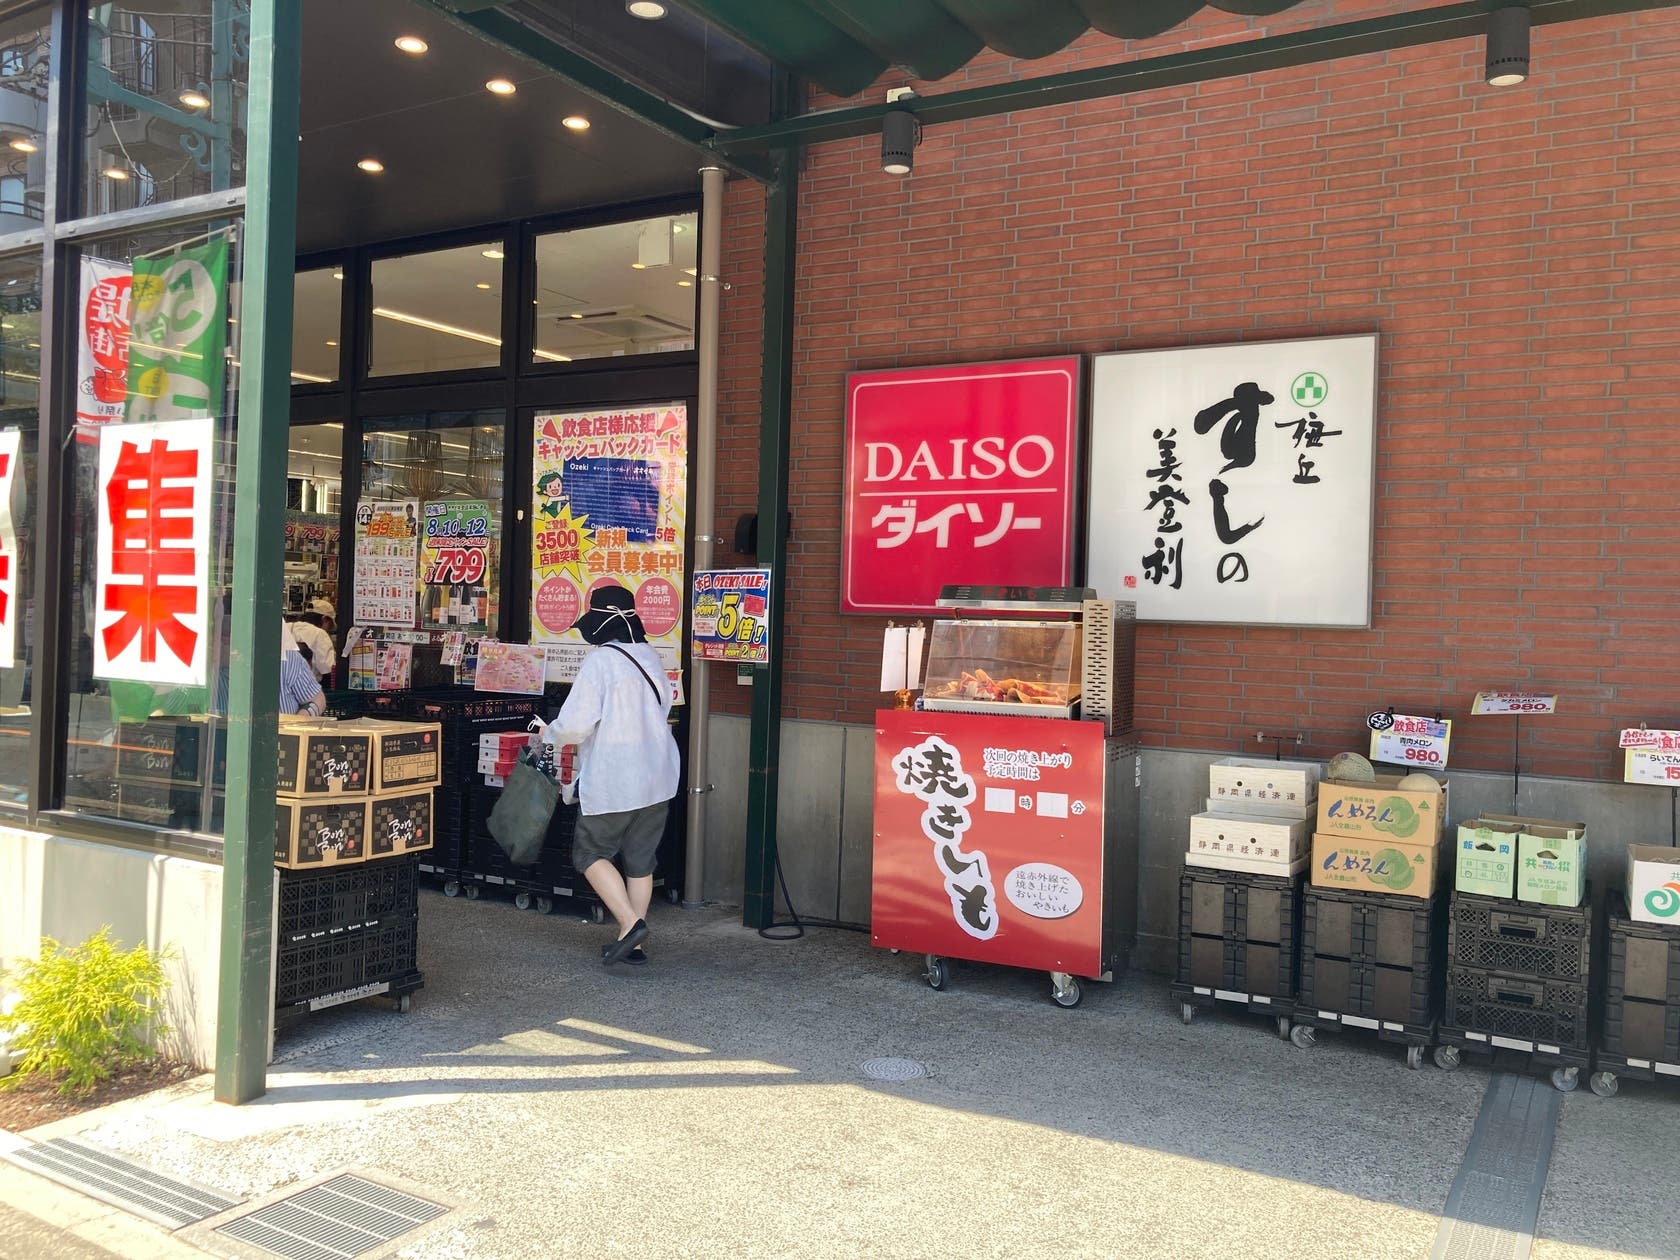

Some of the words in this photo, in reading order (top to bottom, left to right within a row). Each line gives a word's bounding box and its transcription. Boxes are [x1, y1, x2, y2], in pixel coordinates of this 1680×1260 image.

[561, 412, 656, 438] 飲食店様応援
[538, 433, 681, 460] キャッシュバックカード
[1274, 411, 1343, 484] 梅丘
[570, 462, 589, 471] Ozeki
[864, 434, 1055, 482] DAISO
[1195, 381, 1275, 584] すしの
[1141, 428, 1191, 590] 美登利
[871, 502, 1042, 549] ダイソー
[536, 529, 578, 550] 3500
[596, 529, 628, 548] 新規
[656, 527, 676, 542] 5倍
[102, 439, 198, 668] 集
[539, 549, 580, 566] 店舗突破
[588, 551, 683, 575] 会員募集中!
[543, 585, 571, 594] ポイントが
[646, 584, 669, 595] 年会費
[695, 574, 712, 591] 本日
[713, 575, 739, 588] OZEKI
[642, 596, 671, 606] 2000円
[695, 604, 718, 617] POINT
[1393, 720, 1427, 734] 飲食店
[324, 758, 349, 773] Bon
[984, 748, 1072, 768] 次回の焼き上がり
[985, 764, 1040, 780] 予定時間は
[1217, 787, 1296, 801] 静岡県経済連
[1020, 796, 1031, 809] 時
[1073, 801, 1086, 814] 分
[1327, 799, 1394, 823] んめろん
[388, 818, 412, 832] Bon
[318, 827, 344, 842] Bon
[899, 743, 991, 932] 焼きいも
[1198, 840, 1280, 858] 静岡県経済連
[1323, 851, 1389, 876] んめろん
[1015, 870, 1069, 884] 遠赤外線で
[1015, 880, 1069, 895] 焼き上げた
[1015, 889, 1058, 901] おいしい
[1033, 900, 1070, 913] やきいも
